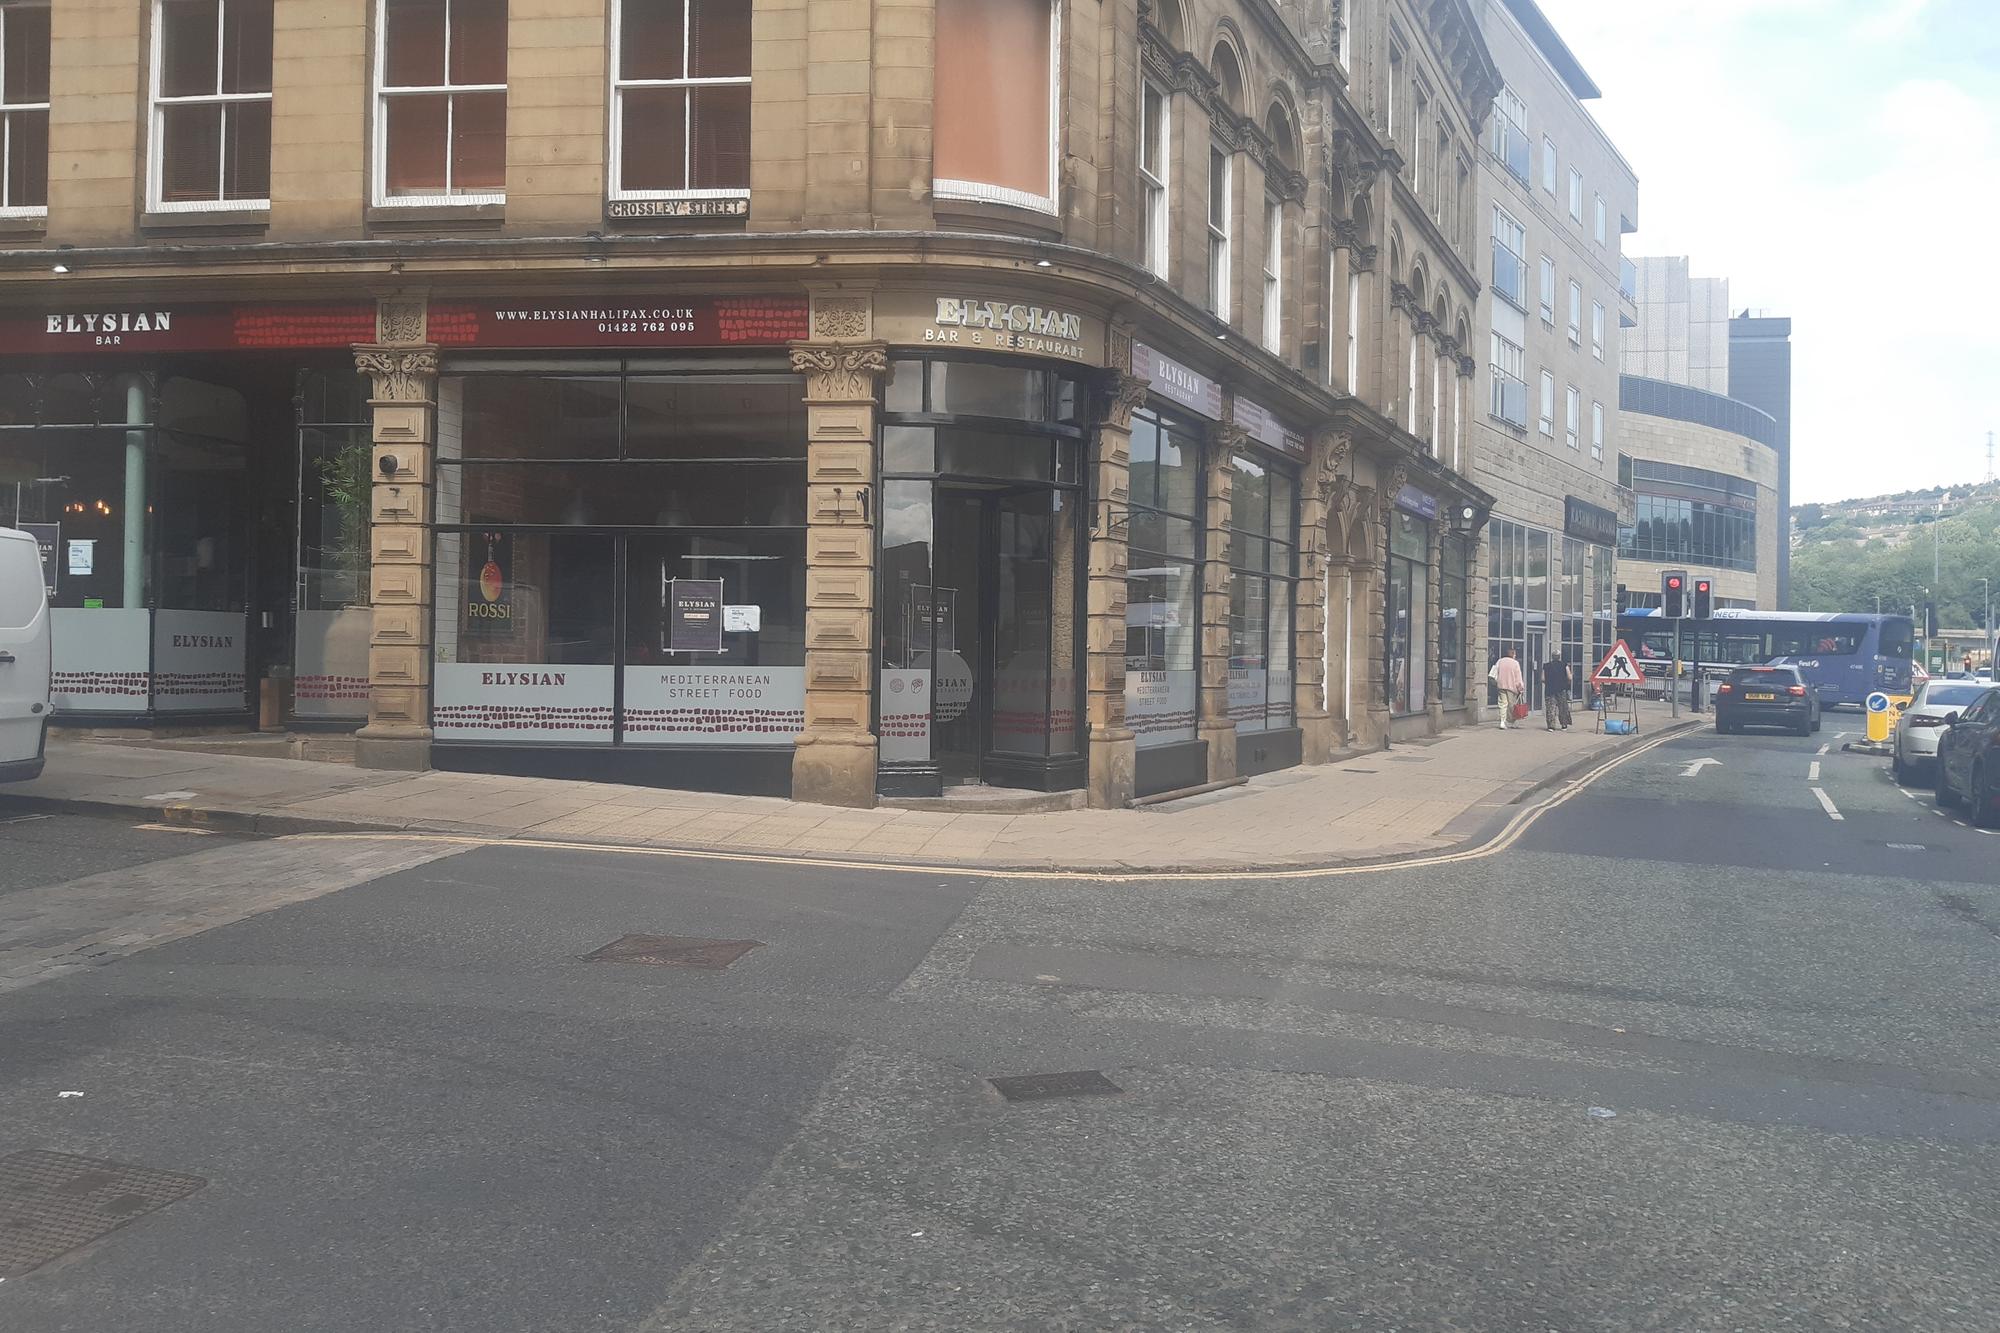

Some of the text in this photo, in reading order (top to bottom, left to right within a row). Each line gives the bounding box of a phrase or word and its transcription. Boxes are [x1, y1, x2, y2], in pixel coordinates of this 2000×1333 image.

[612, 200, 740, 216] CROSSLEY STREET
[496, 309, 694, 320] WWW.ELYSIANHALIFAX.CO.UK
[936, 297, 1081, 341] ELYSIAN
[46, 312, 171, 333] ELYSIAN
[598, 322, 695, 333] 01422 762 095
[95, 335, 121, 345] BAR
[924, 328, 1085, 359] BAR & RESTAURANT
[1159, 360, 1199, 395] ELYSIAN
[678, 600, 715, 608] ELYSIAN
[468, 602, 510, 619] ROSSI
[1713, 611, 1741, 619] NECT
[173, 635, 232, 648] ELYSIAN
[481, 672, 566, 686] ELYSIAN
[661, 675, 770, 685] MEDITERRANEAN
[1140, 671, 1167, 682] ELYSIAN
[937, 678, 967, 688] SIAN
[669, 688, 762, 699] STREET FOOD
